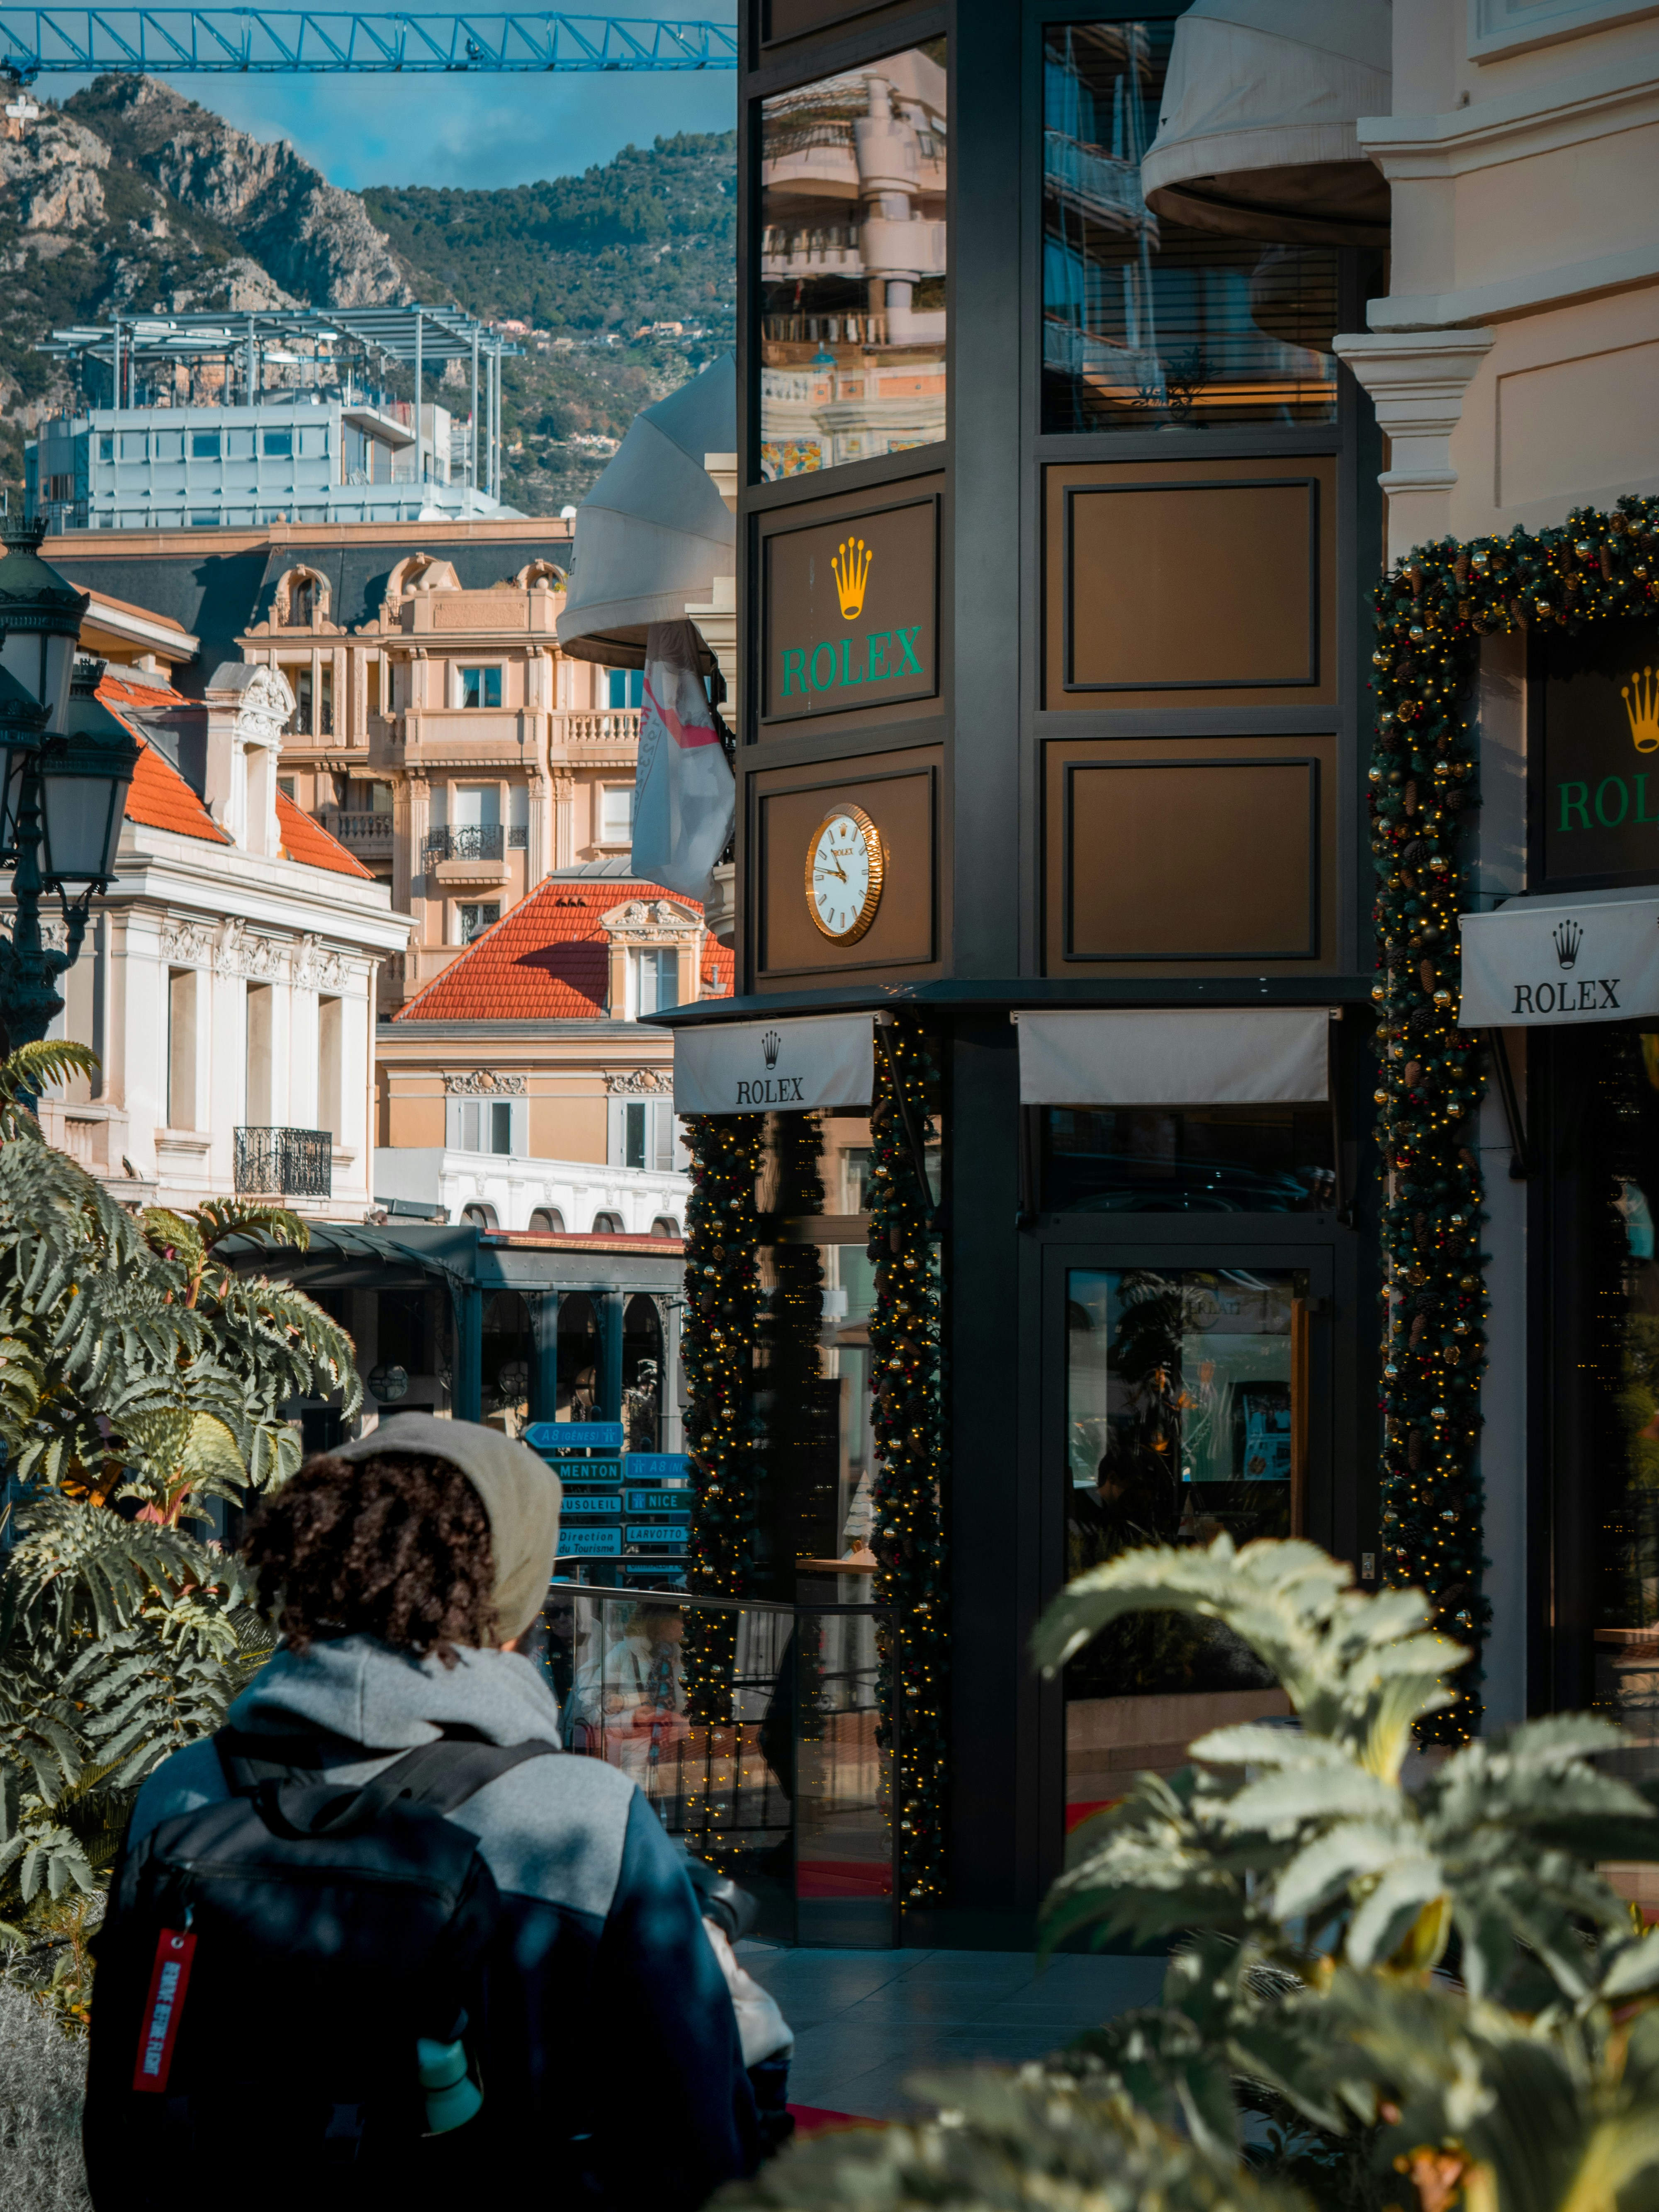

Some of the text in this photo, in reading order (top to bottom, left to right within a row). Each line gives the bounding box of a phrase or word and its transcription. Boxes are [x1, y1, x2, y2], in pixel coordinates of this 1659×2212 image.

[780, 625, 924, 697] ROLEX
[1511, 979, 1620, 1014] ROLEX
[736, 1077, 804, 1105] ROLEX
[560, 1465, 617, 1477] MENTON
[669, 1462, 683, 1472] (NI
[649, 1495, 677, 1507] NICE
[560, 1531, 613, 1541] Direction
[630, 1530, 681, 1539] LARVOTTO
[559, 1543, 614, 1553] du Tourisme
